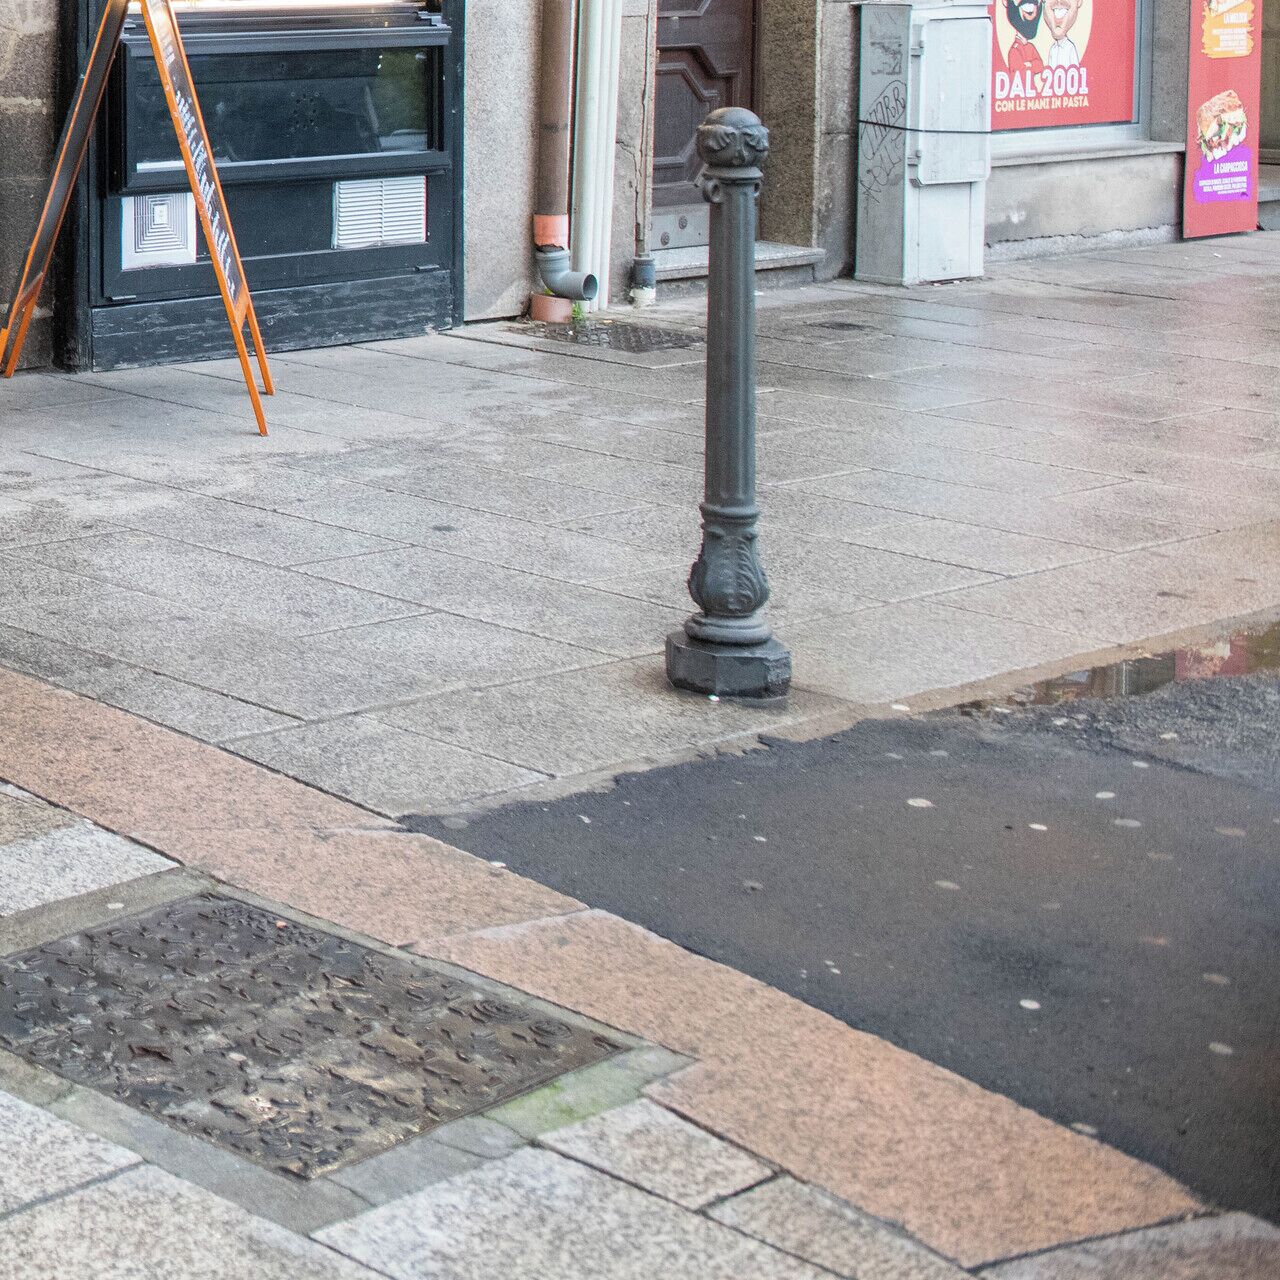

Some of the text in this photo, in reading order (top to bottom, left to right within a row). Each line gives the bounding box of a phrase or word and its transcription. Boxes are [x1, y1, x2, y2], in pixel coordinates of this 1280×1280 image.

[994, 67, 1089, 100] DAL 2001
[994, 95, 1089, 113] CON LE MANI IN PASTA
